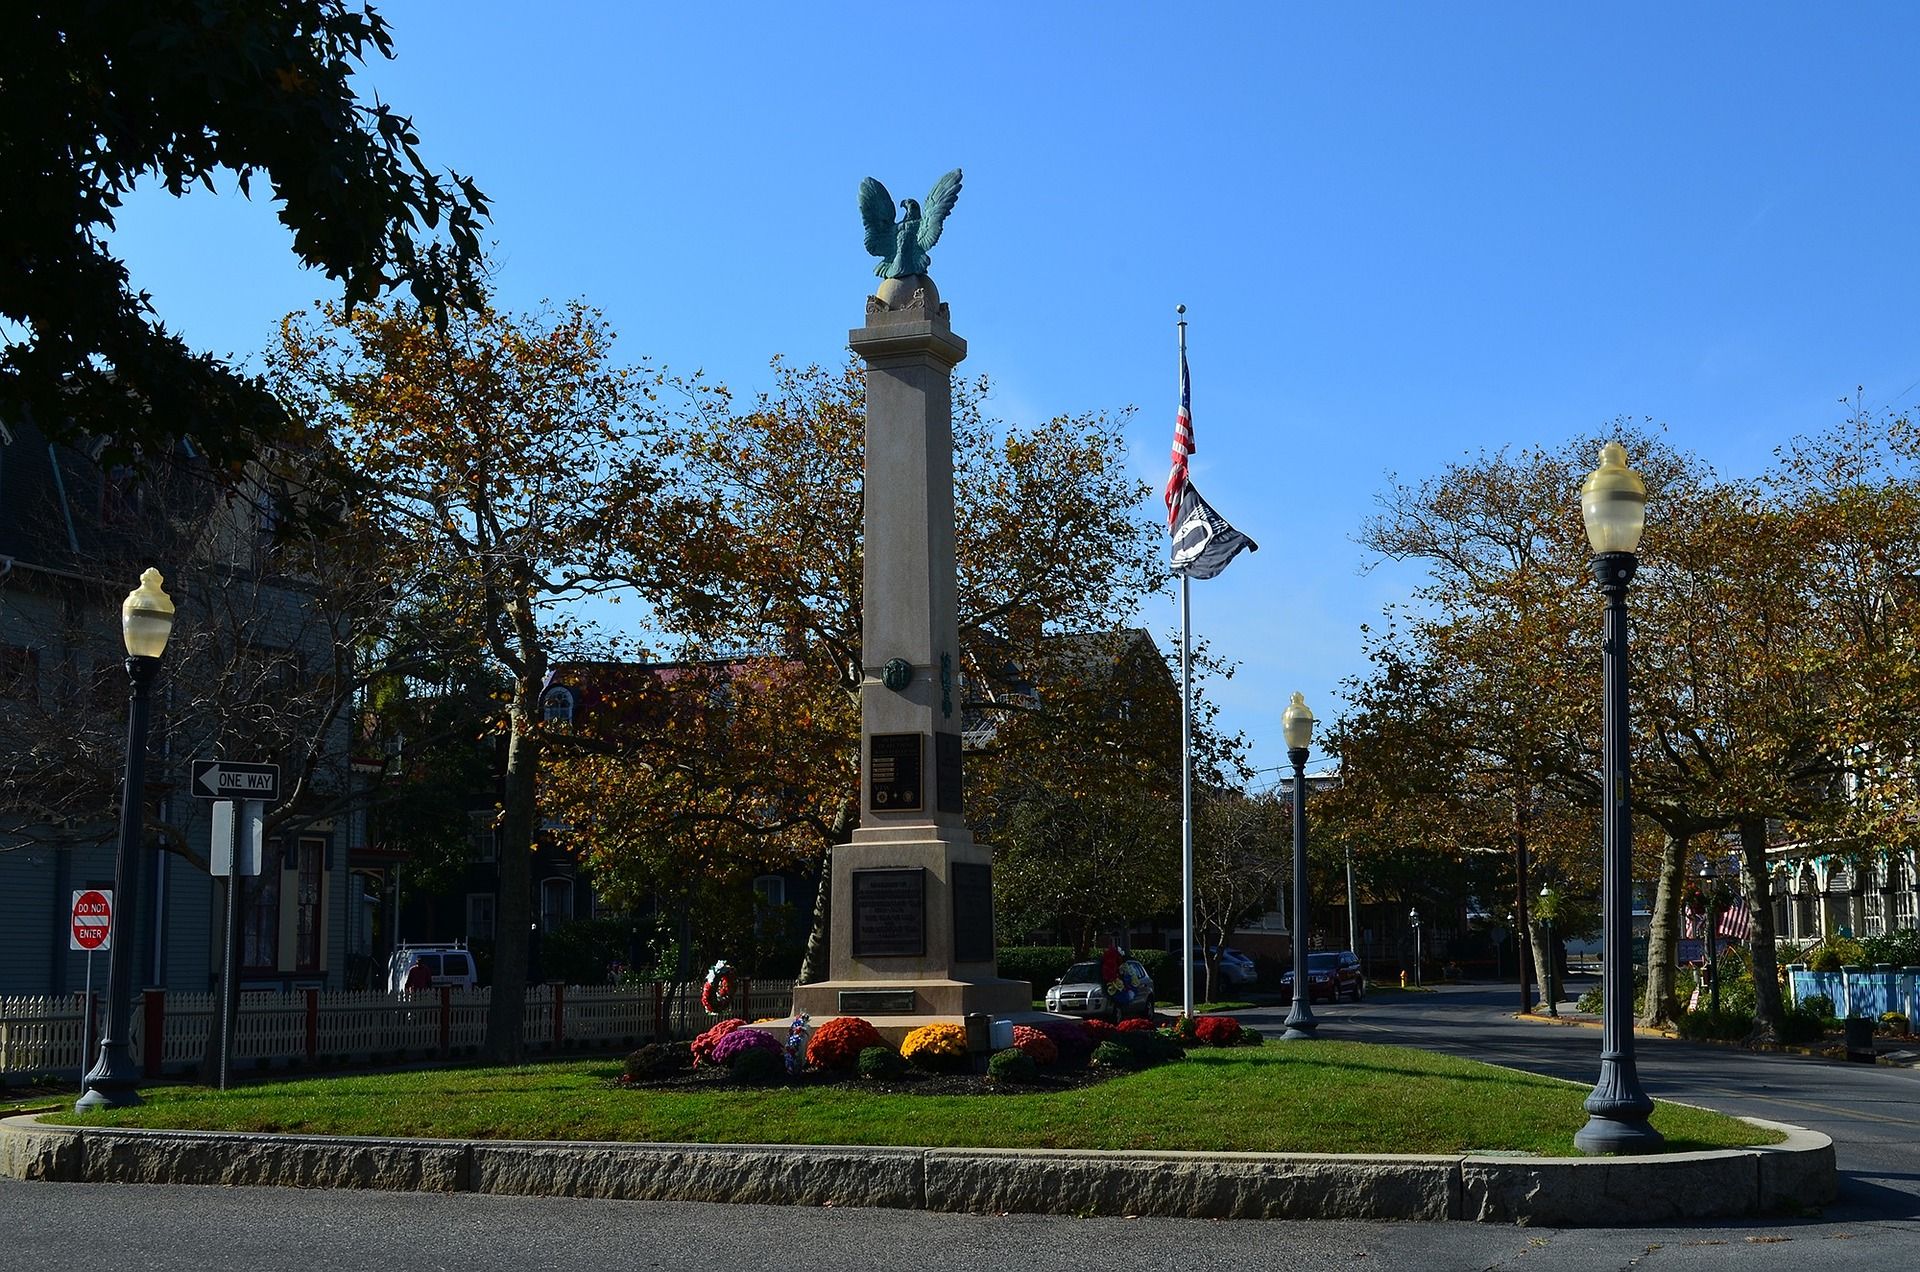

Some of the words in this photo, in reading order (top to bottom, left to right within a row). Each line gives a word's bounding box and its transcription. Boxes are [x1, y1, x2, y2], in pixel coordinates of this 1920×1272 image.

[219, 773, 242, 787] ONE
[248, 774, 271, 788] WAY
[78, 903, 89, 913] DO
[91, 903, 106, 913] NOT
[79, 929, 102, 939] ENTER
